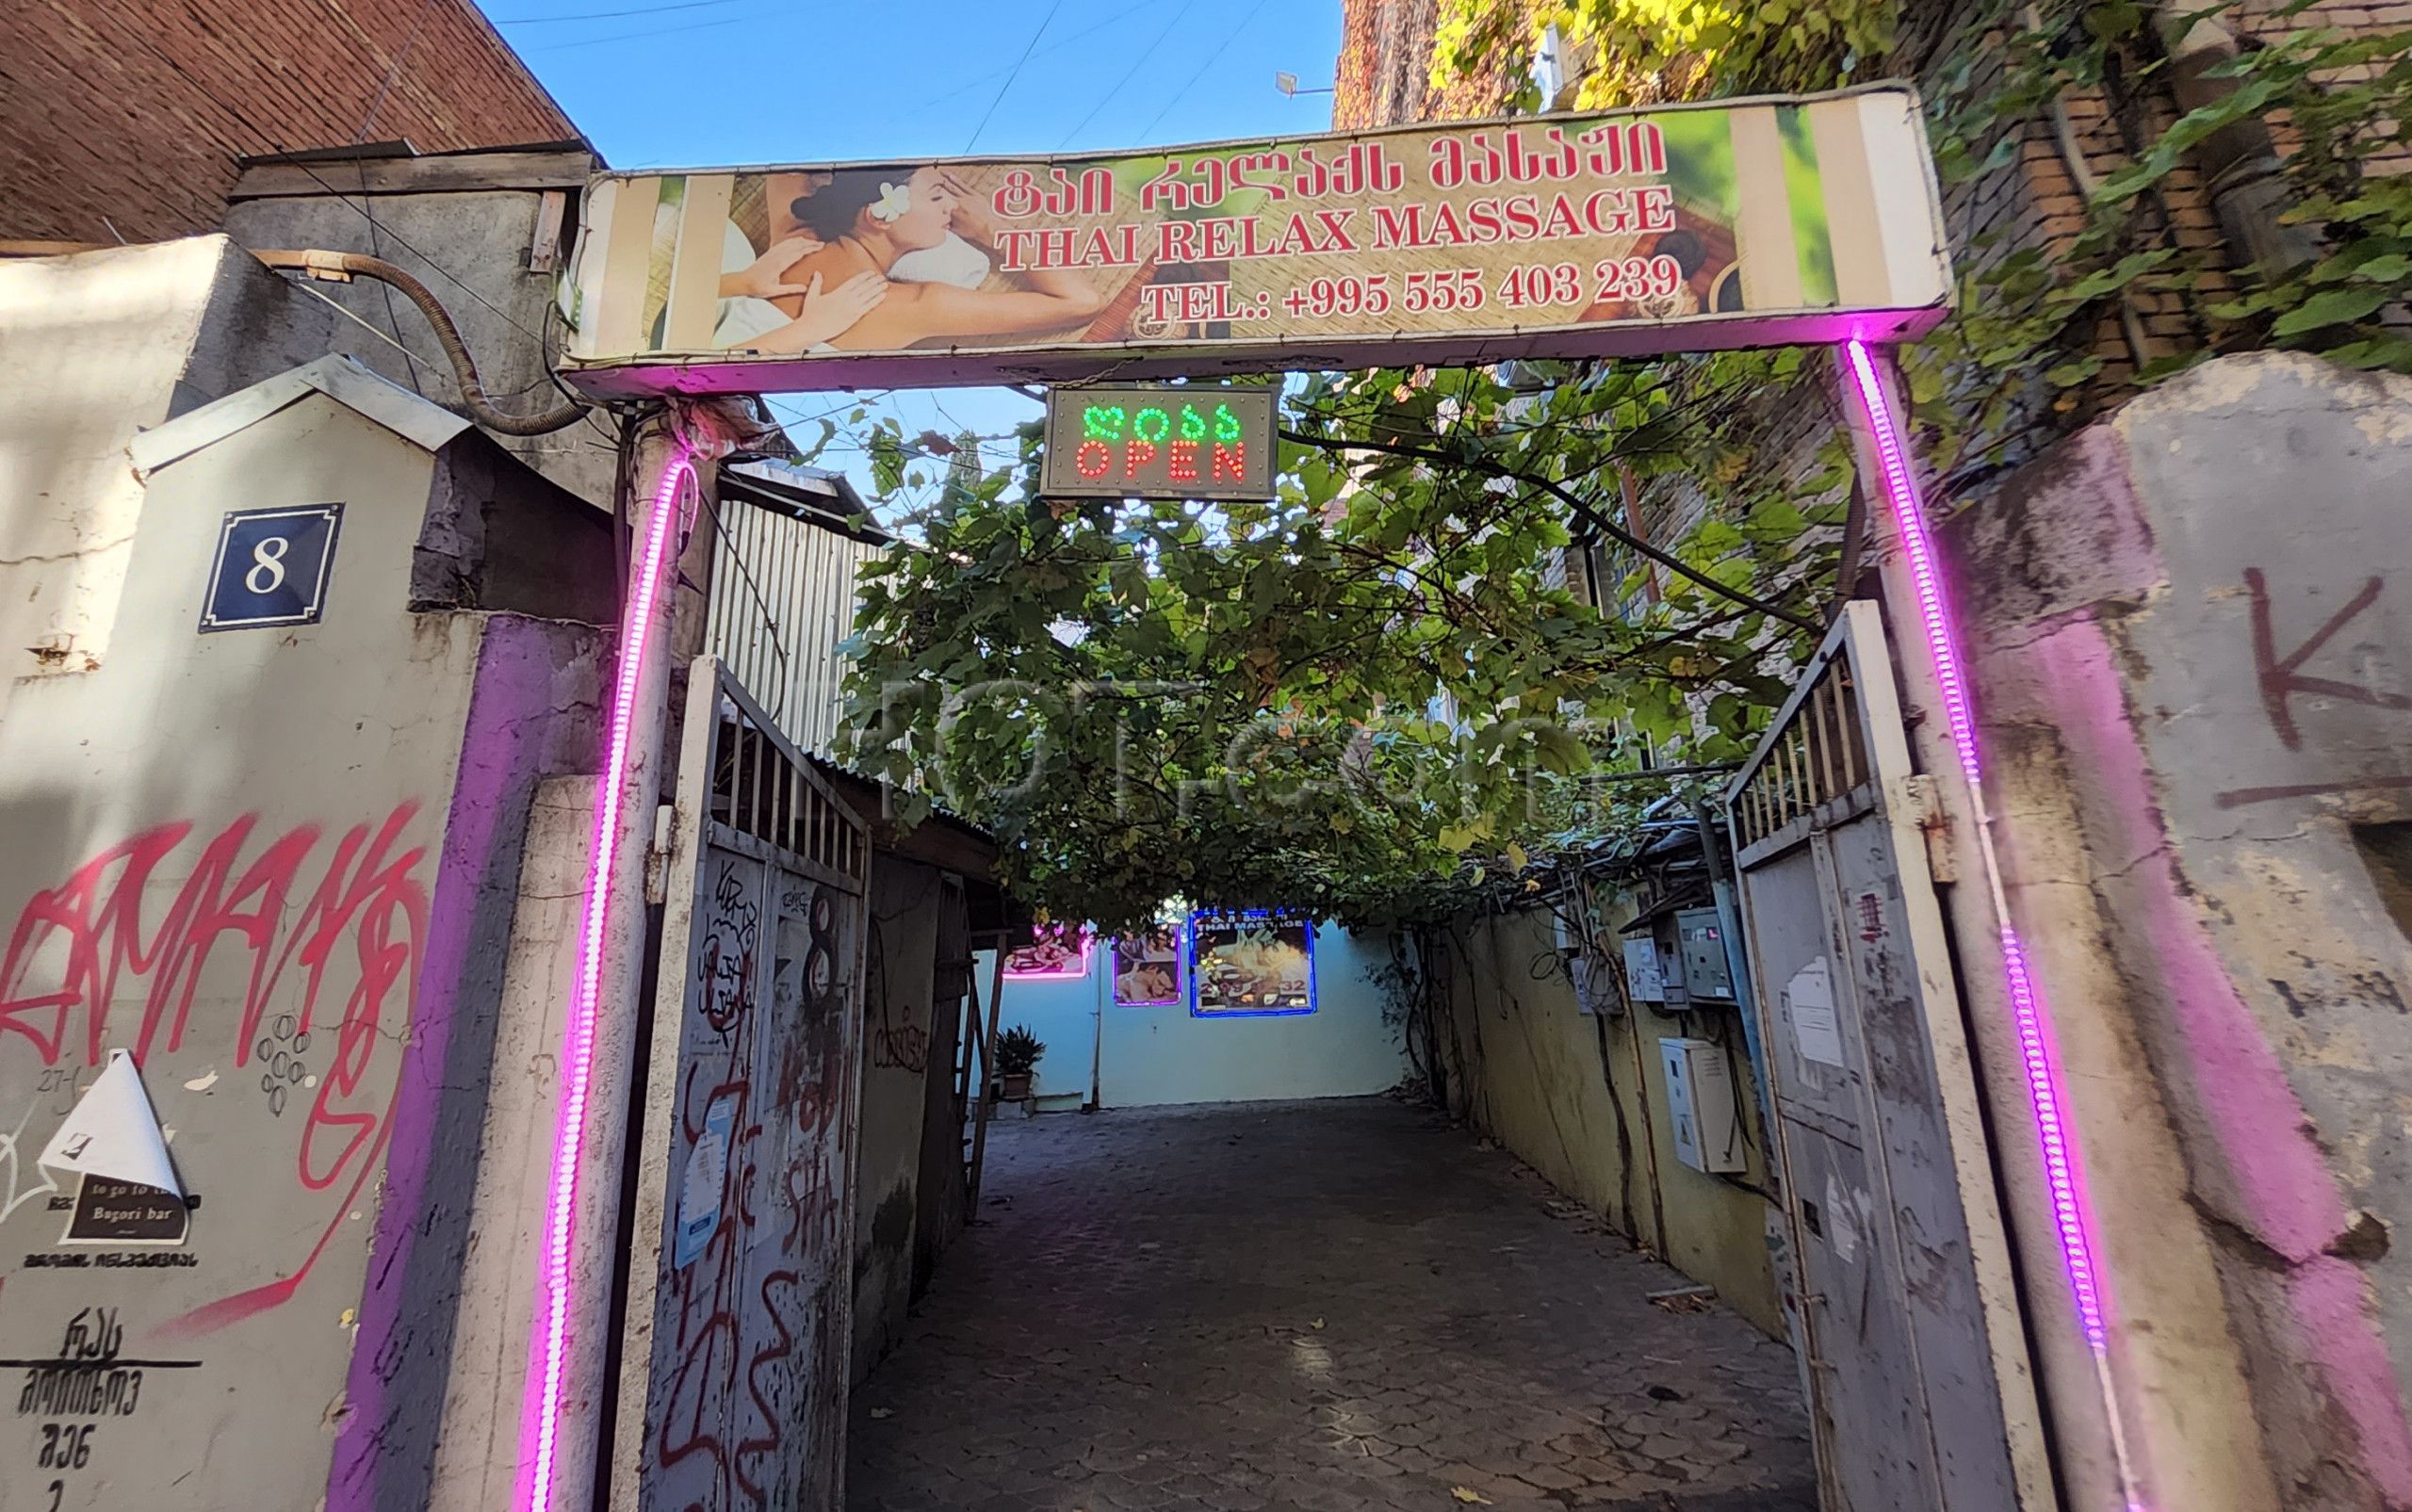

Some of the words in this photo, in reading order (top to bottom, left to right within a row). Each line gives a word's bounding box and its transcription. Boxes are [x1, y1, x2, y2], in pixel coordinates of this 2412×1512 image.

[992, 168, 1115, 217] ტაი
[1140, 143, 1404, 212] რელაქს
[1428, 122, 1668, 189] მასაჟი
[994, 224, 1142, 272] THAI
[1154, 207, 1360, 265] RELAX
[1371, 186, 1676, 250] MASSAGE
[1141, 281, 1271, 325] TEL.:
[1282, 272, 1391, 318] +995
[1404, 268, 1486, 315] 555
[1498, 262, 1582, 308] 403
[1594, 253, 1682, 303] 239
[1076, 439, 1245, 480] OPEN
[245, 536, 288, 594] 8
[1197, 922, 1230, 932] THAI
[146, 1207, 172, 1220] bar
